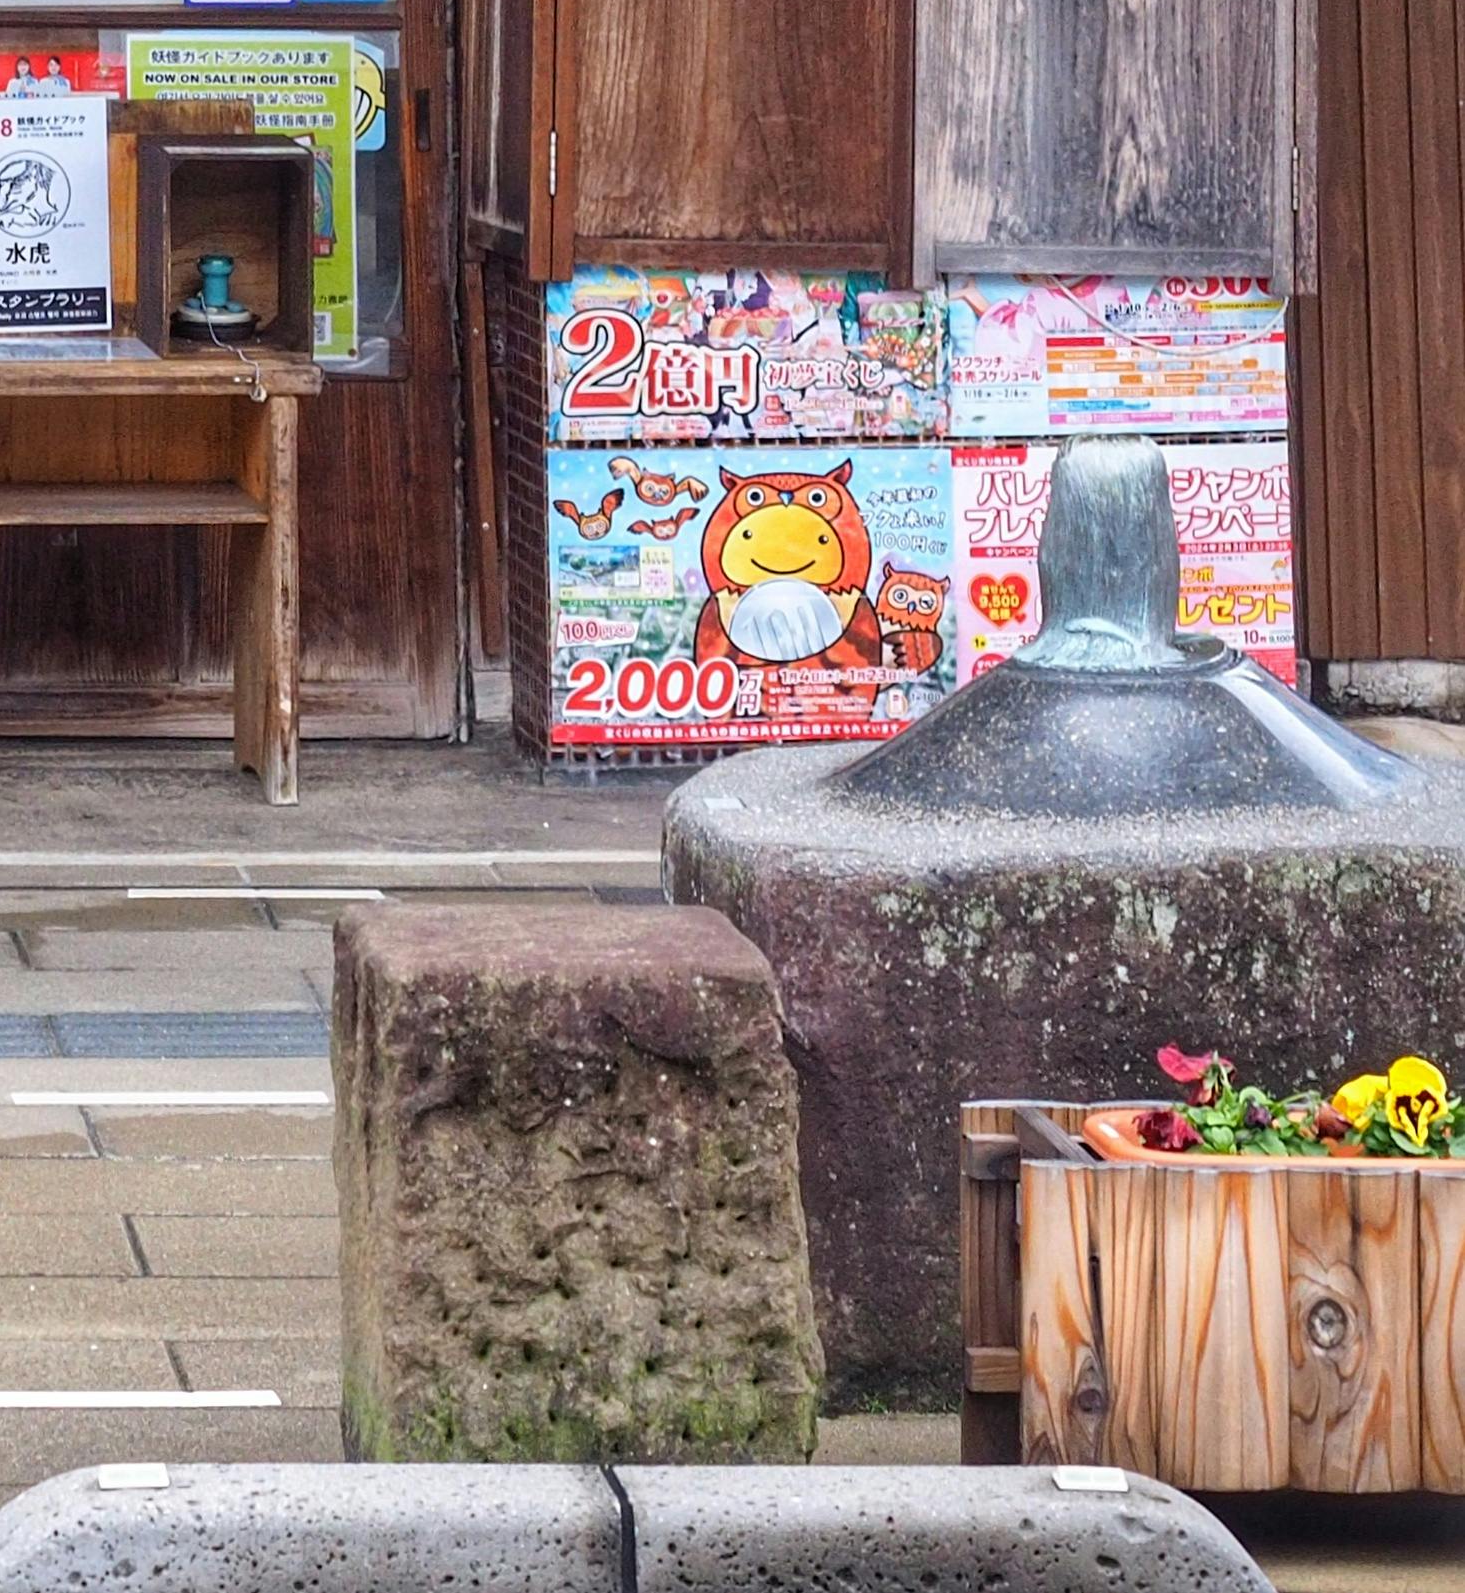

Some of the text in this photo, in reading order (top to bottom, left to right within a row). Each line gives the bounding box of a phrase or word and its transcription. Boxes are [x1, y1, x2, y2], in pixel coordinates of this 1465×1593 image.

[151, 49, 330, 66] 妖怪ガイドブックあります
[145, 74, 337, 85] NOW ON SALE IN OUR STORE
[5, 242, 51, 266] 水虎
[562, 308, 759, 415] 2億円
[952, 357, 1003, 369] スクラッチ
[951, 370, 1042, 384] 発売スケジュール
[977, 471, 1052, 506] バレ
[563, 656, 738, 719] 2,000
